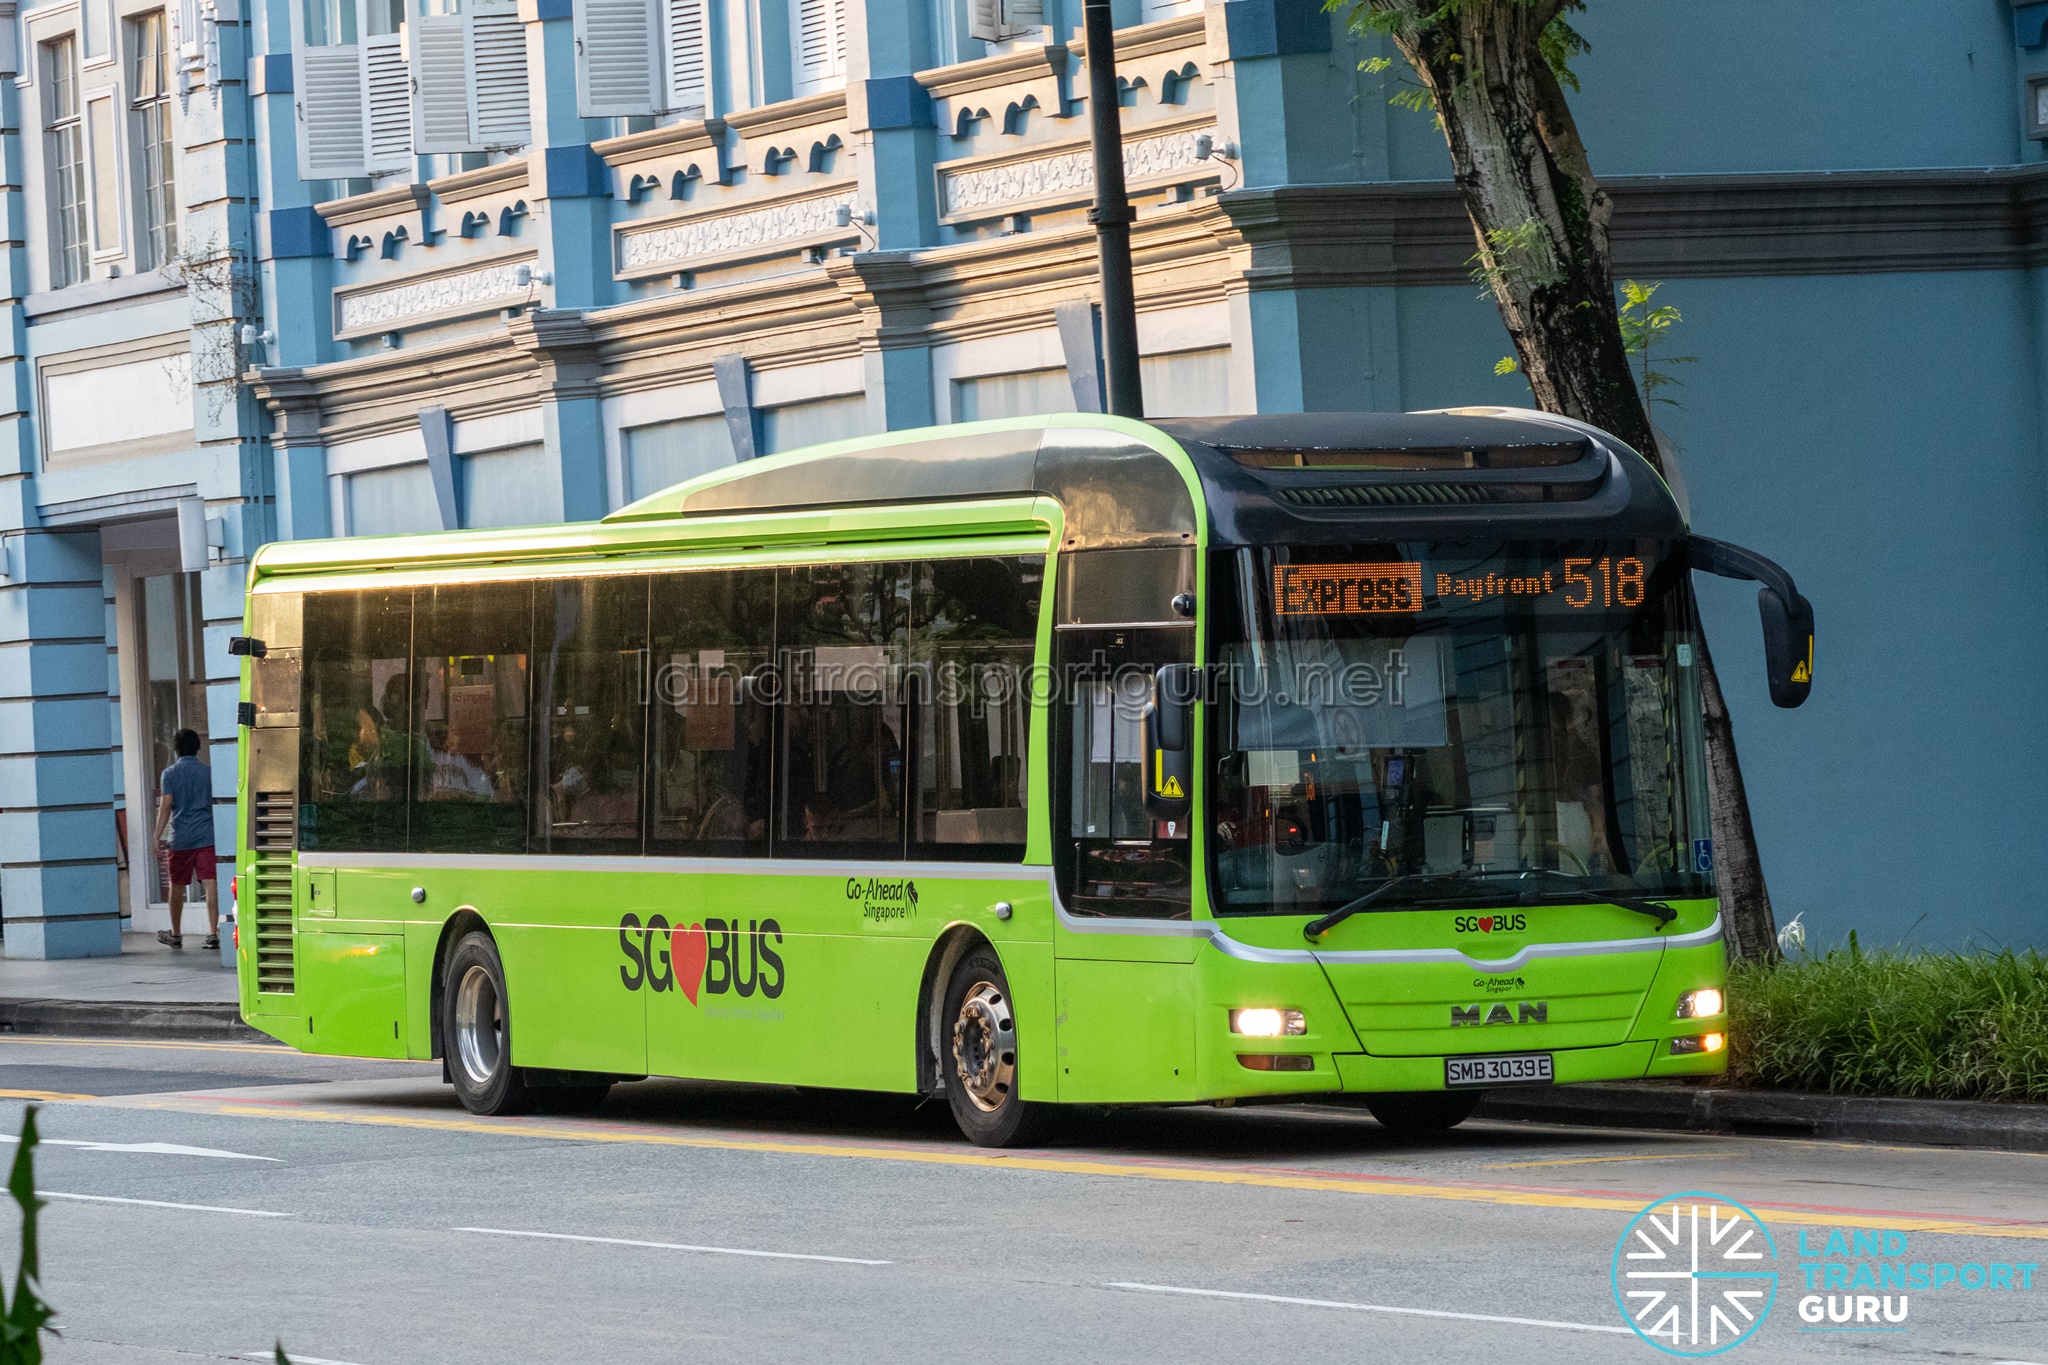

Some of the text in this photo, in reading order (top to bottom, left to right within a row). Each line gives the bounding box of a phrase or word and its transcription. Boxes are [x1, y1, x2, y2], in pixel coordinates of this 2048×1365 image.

[1283, 557, 1645, 610] Express Bayfront 518
[846, 878, 903, 902] Go-Ahead
[863, 901, 905, 922] Singapore
[1473, 977, 1515, 989] Go-Ahead
[1451, 1002, 1548, 1026] MAN
